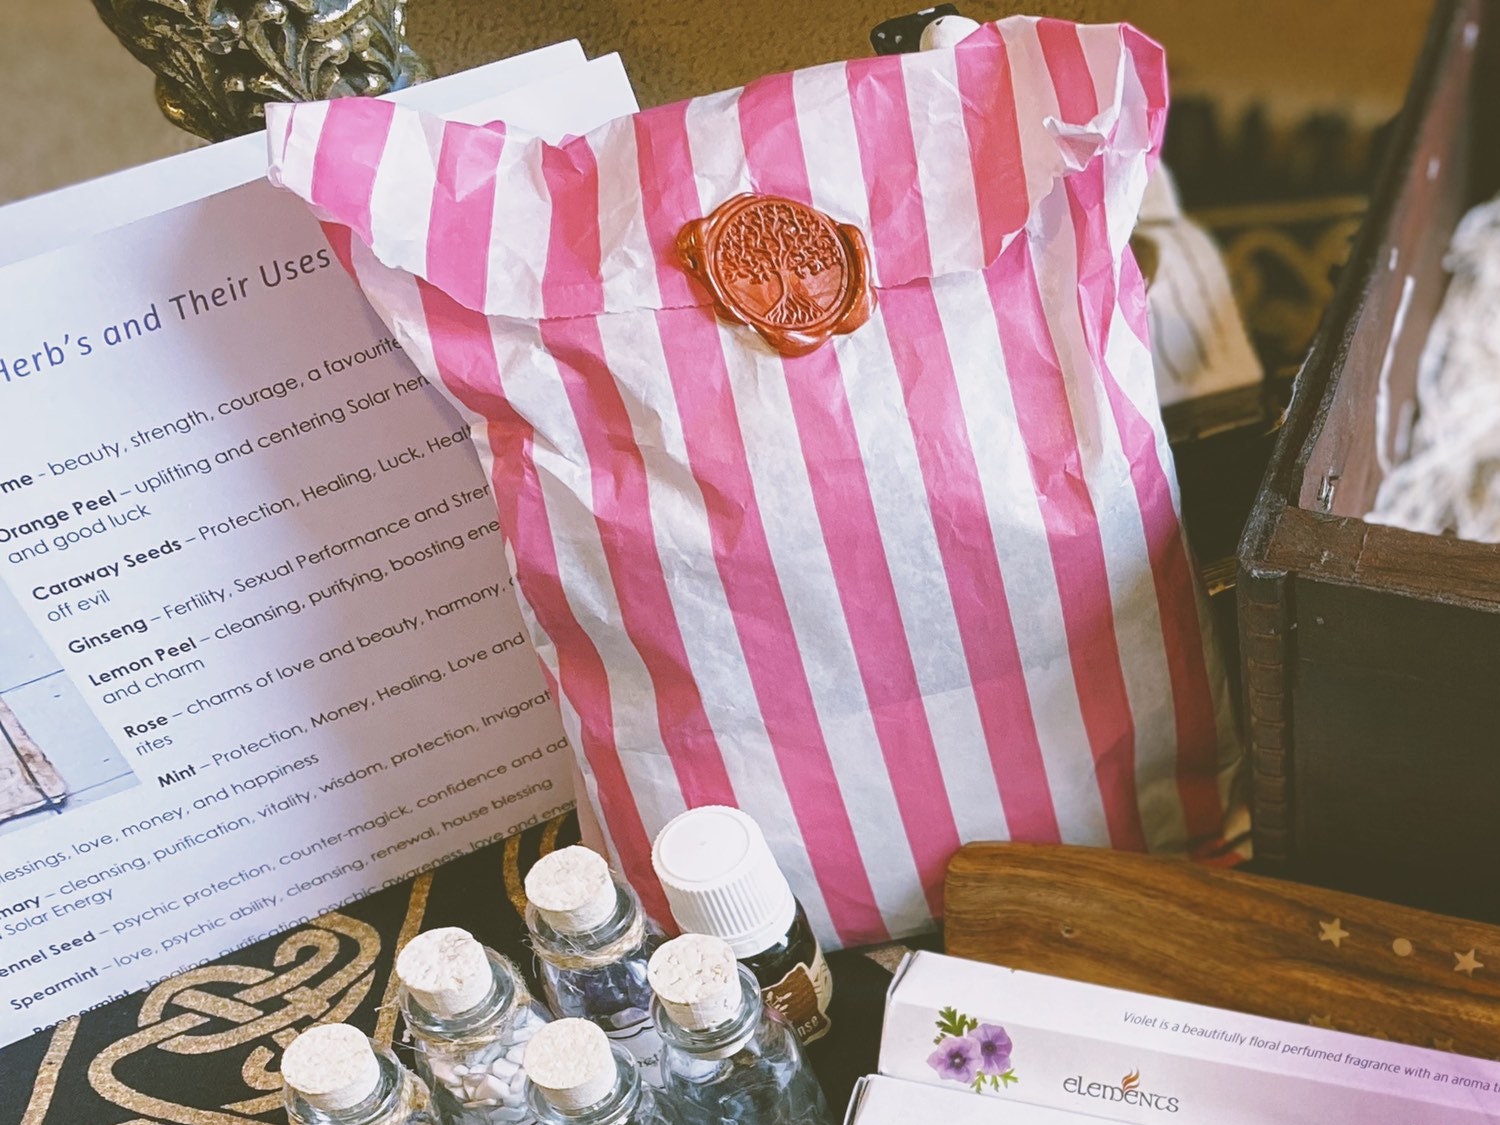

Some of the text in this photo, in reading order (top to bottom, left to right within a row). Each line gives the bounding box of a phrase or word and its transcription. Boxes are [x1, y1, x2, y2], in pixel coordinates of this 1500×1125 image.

[104, 303, 161, 346] and
[168, 277, 248, 320] Their
[259, 249, 330, 287] Uses
[47, 443, 127, 476] beauty,
[130, 411, 214, 447] strength,
[218, 378, 304, 415] courage,
[72, 489, 117, 515] Peel
[134, 459, 212, 493] uplifting
[215, 439, 254, 464] and
[258, 408, 346, 448] centering
[346, 389, 390, 414] Solar
[8, 504, 151, 563] and good luck
[32, 447, 424, 600] Caraway Seeds Protection, Healing, Luck,
[68, 499, 450, 653] Ginseng Fertility, Sexual Performance and
[48, 589, 110, 622] off evil
[88, 536, 465, 686] Lemon Peel cleansing, purifying, boosting
[123, 584, 506, 738] Rose charms love and beauty, harmony,
[103, 660, 205, 704] and charm
[157, 632, 525, 788] Mint Protection, Money, Healing, Love and
[136, 736, 173, 756] rites
[49, 748, 543, 955] Seed psychic protection, counter-magick, confidence and
[60, 858, 150, 894] cleansing,
[153, 817, 255, 862] purification,
[257, 791, 317, 817] vitality,
[318, 763, 388, 792] wisdom,
[390, 725, 479, 767] protection,
[72, 754, 319, 855] love, money, and happiness
[4, 889, 112, 937] Solar Energy
[10, 779, 553, 1010] Spearmint love, psychic ability, cleansing, renewal, house blessing
[1124, 1012, 1157, 1027] Violet
[1182, 1024, 1246, 1045] beautifully
[1249, 1036, 1281, 1050] floral
[1281, 1045, 1342, 1062] perfumed
[1344, 1054, 1400, 1073] fragrance
[1405, 1067, 1430, 1079] with
[1451, 1076, 1490, 1091] aroma
